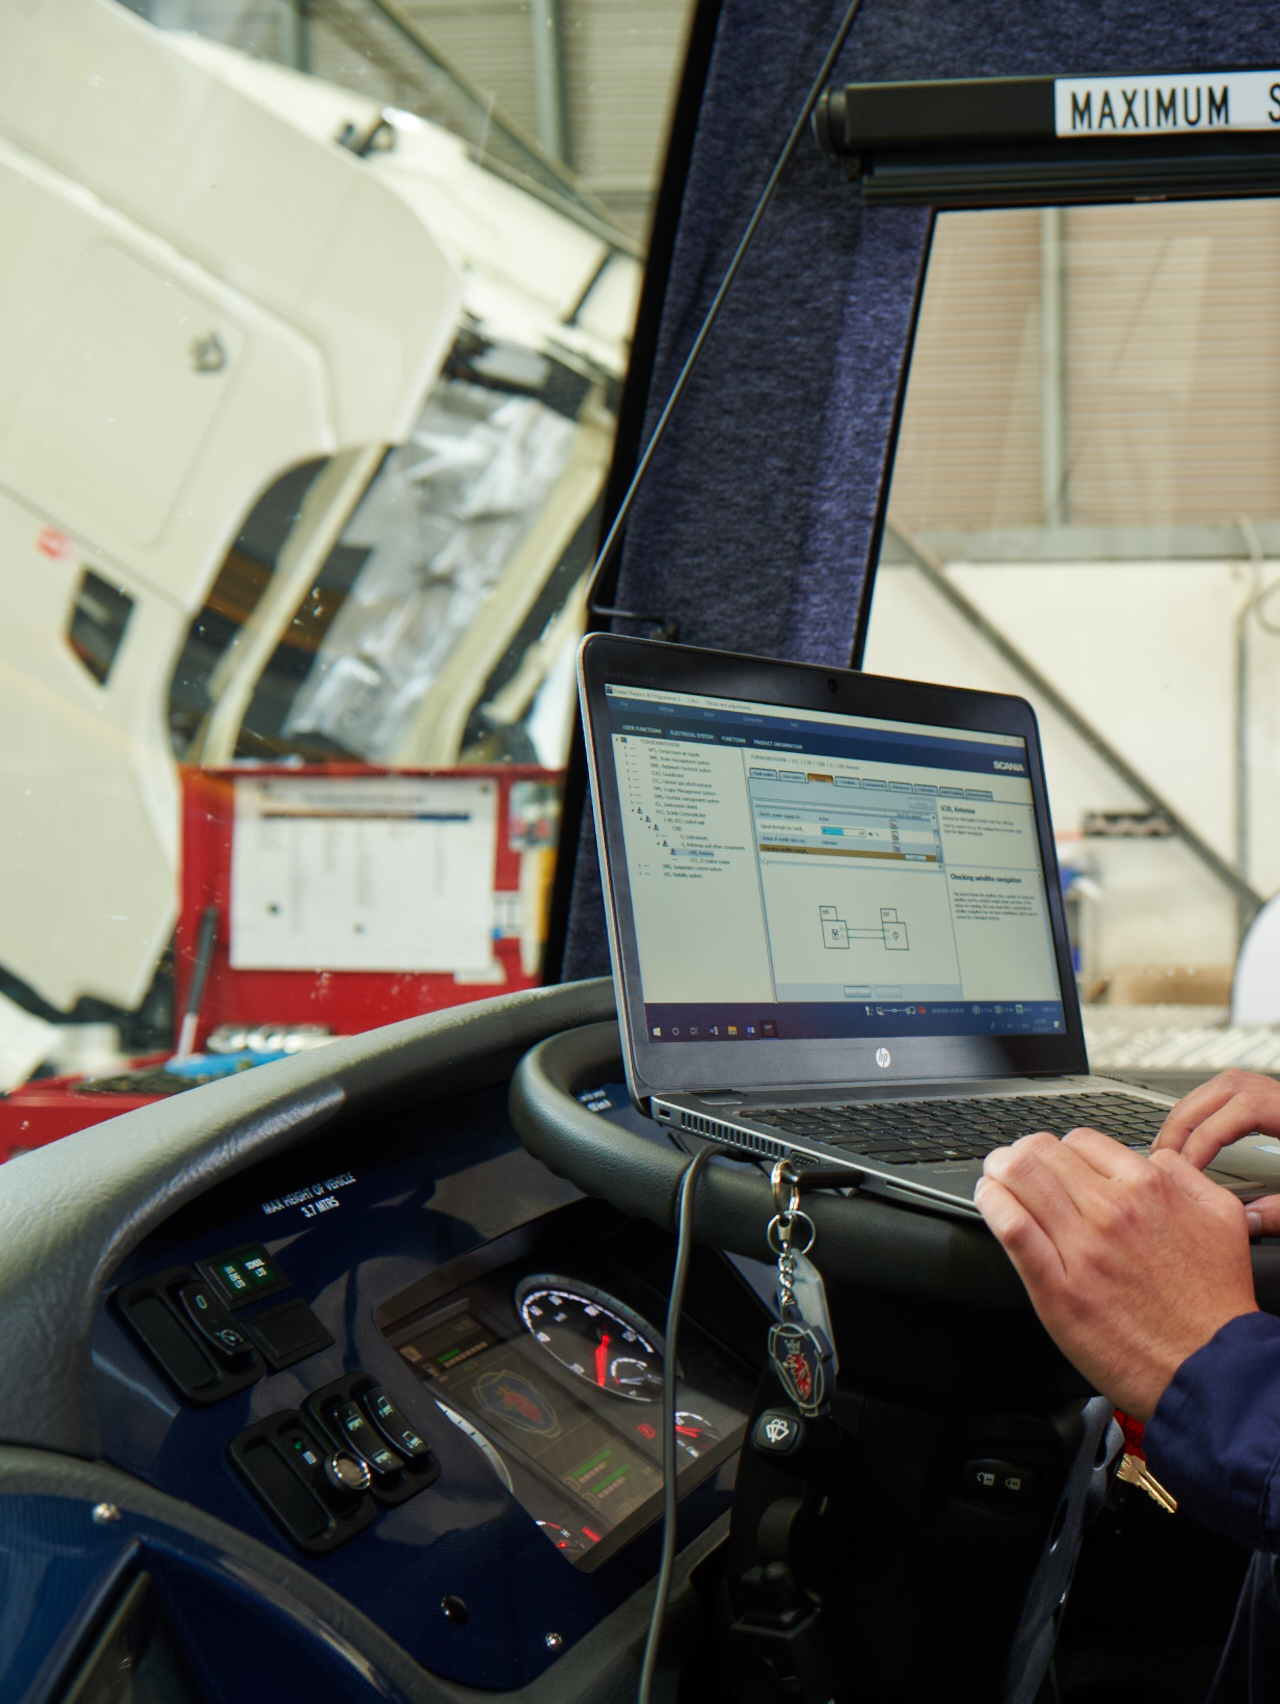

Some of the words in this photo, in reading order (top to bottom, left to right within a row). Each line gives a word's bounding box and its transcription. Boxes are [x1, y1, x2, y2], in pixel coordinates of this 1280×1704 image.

[1071, 85, 1231, 130] MAXIMUM
[621, 724, 635, 732] USER
[635, 725, 662, 735] FUNCTIONS
[669, 729, 696, 738] ELECTRICAL
[696, 732, 714, 740] SYSTEM
[721, 735, 746, 744] FUNCTIONS
[753, 738, 772, 746] PRODUCT
[993, 760, 1025, 772] SCANIA
[950, 872, 974, 882] Checking
[995, 875, 1022, 884] navigation
[876, 1047, 891, 1068] hp
[261, 1198, 286, 1215] MAX
[280, 1187, 314, 1207] HEIGHT
[311, 1182, 325, 1196] OF
[322, 1171, 357, 1191] VEHICLE
[300, 1203, 317, 1218] 3.7
[314, 1195, 340, 1213] MTRS
